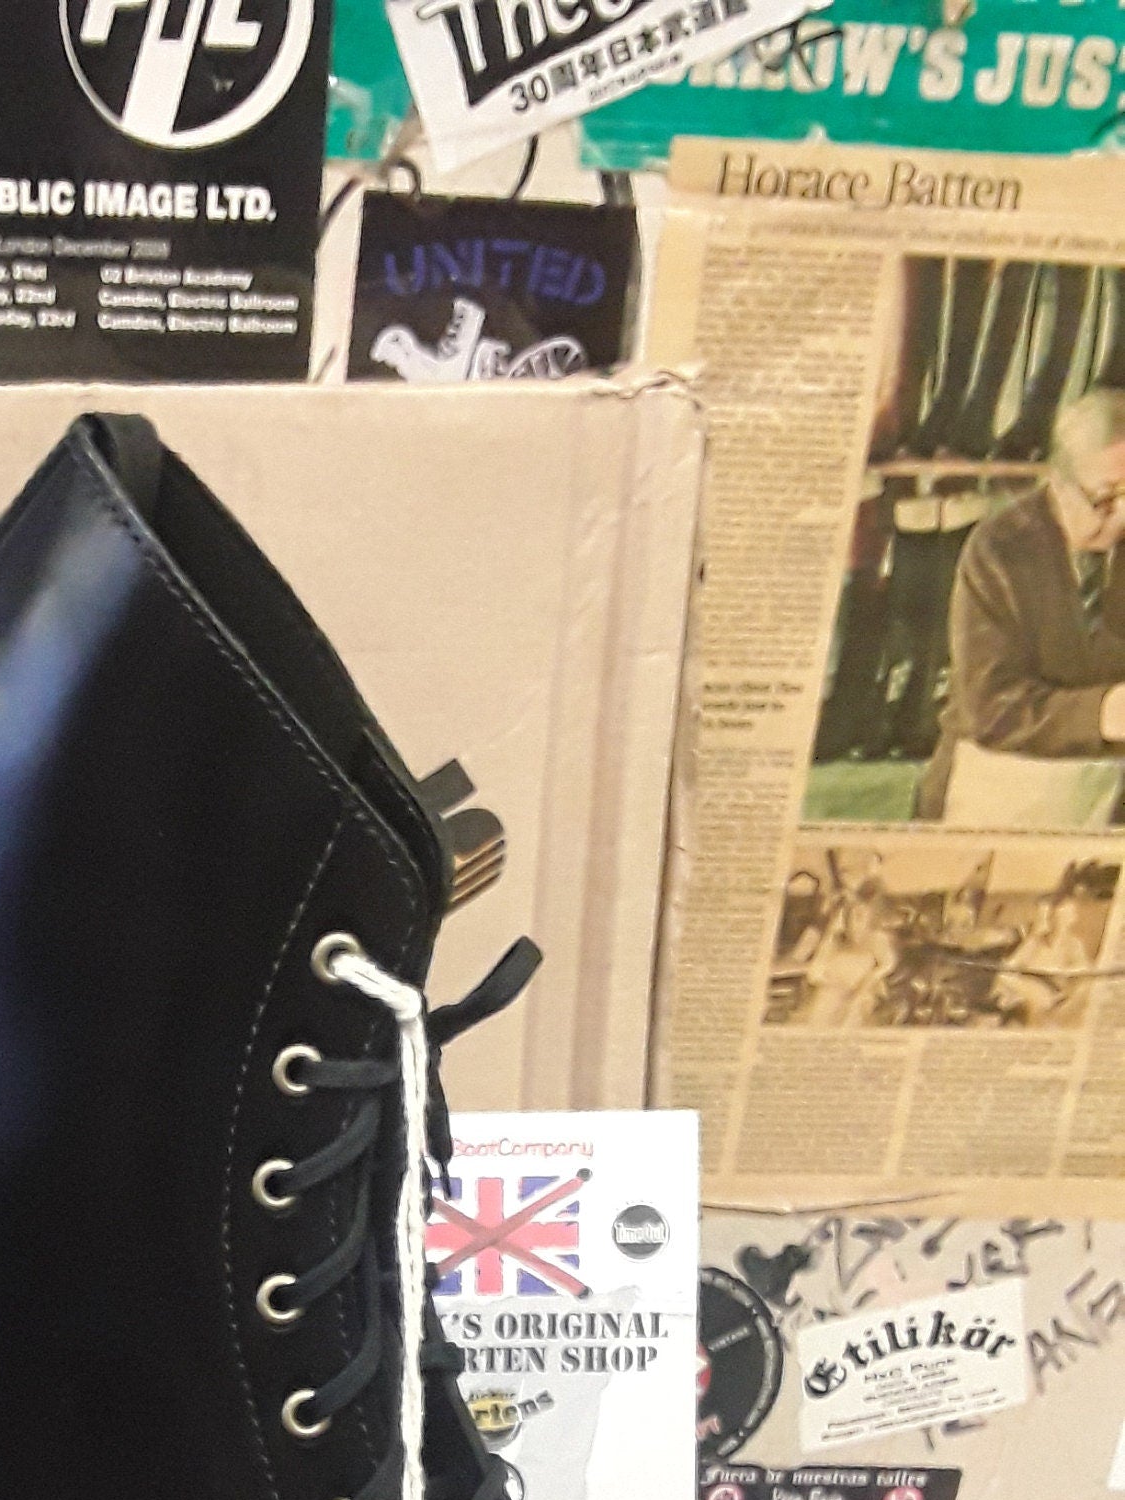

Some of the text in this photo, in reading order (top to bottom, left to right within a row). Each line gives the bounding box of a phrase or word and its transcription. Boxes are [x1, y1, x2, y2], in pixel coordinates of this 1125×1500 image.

[83, 178, 199, 219] IMAGE
[205, 183, 278, 223] LTD.
[717, 152, 1024, 211] Horace Batten
[384, 237, 606, 305] UNITED
[493, 1311, 670, 1341] ORIGINAL
[560, 1345, 659, 1374] SHOP
